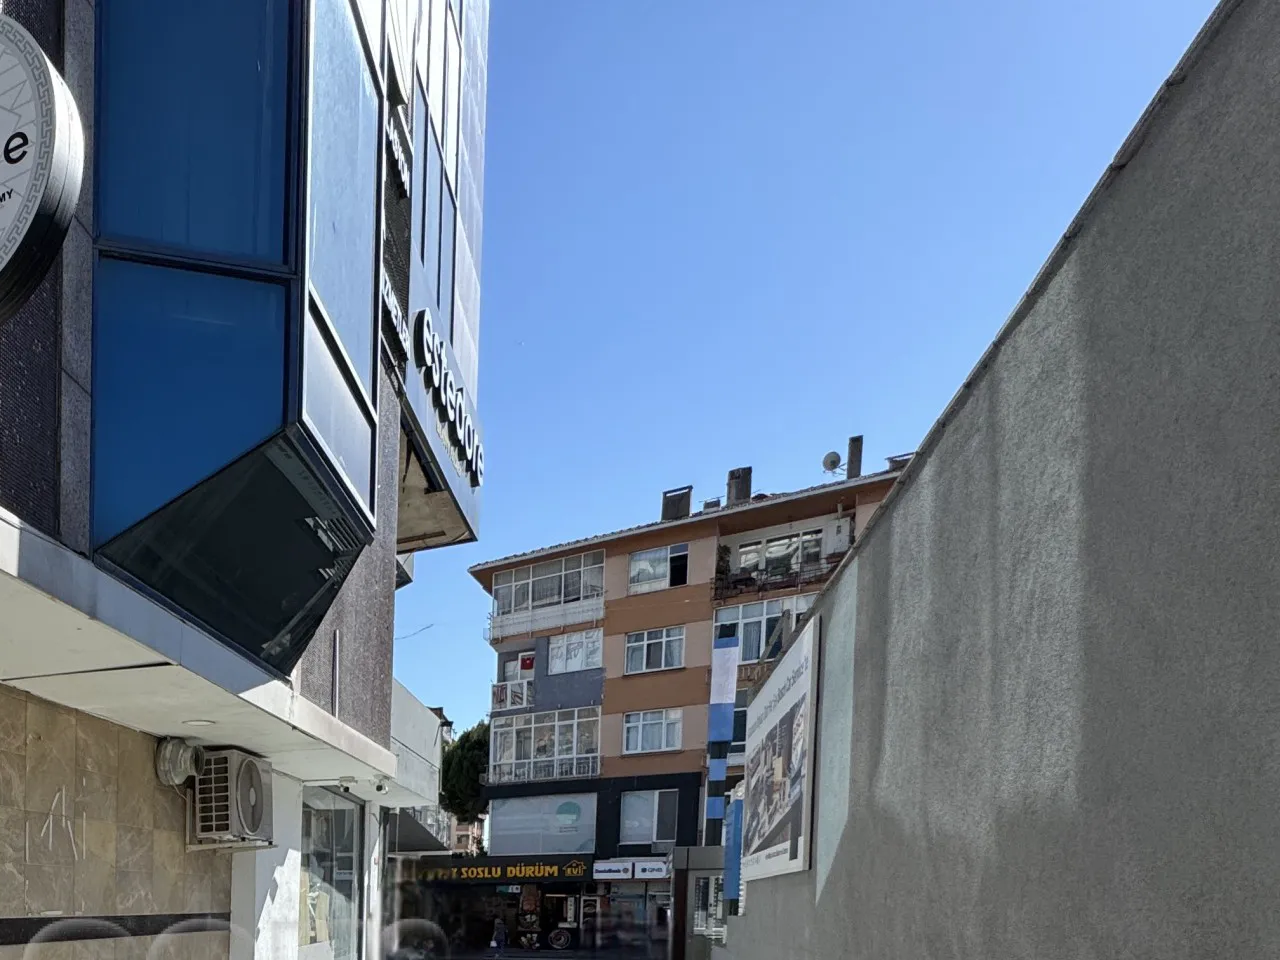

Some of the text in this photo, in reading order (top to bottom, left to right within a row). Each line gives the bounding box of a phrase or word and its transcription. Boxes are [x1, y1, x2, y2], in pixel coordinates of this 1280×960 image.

[423, 307, 484, 487] estedore
[460, 866, 501, 879] SOSLU
[506, 862, 559, 878] DÜRÜM
